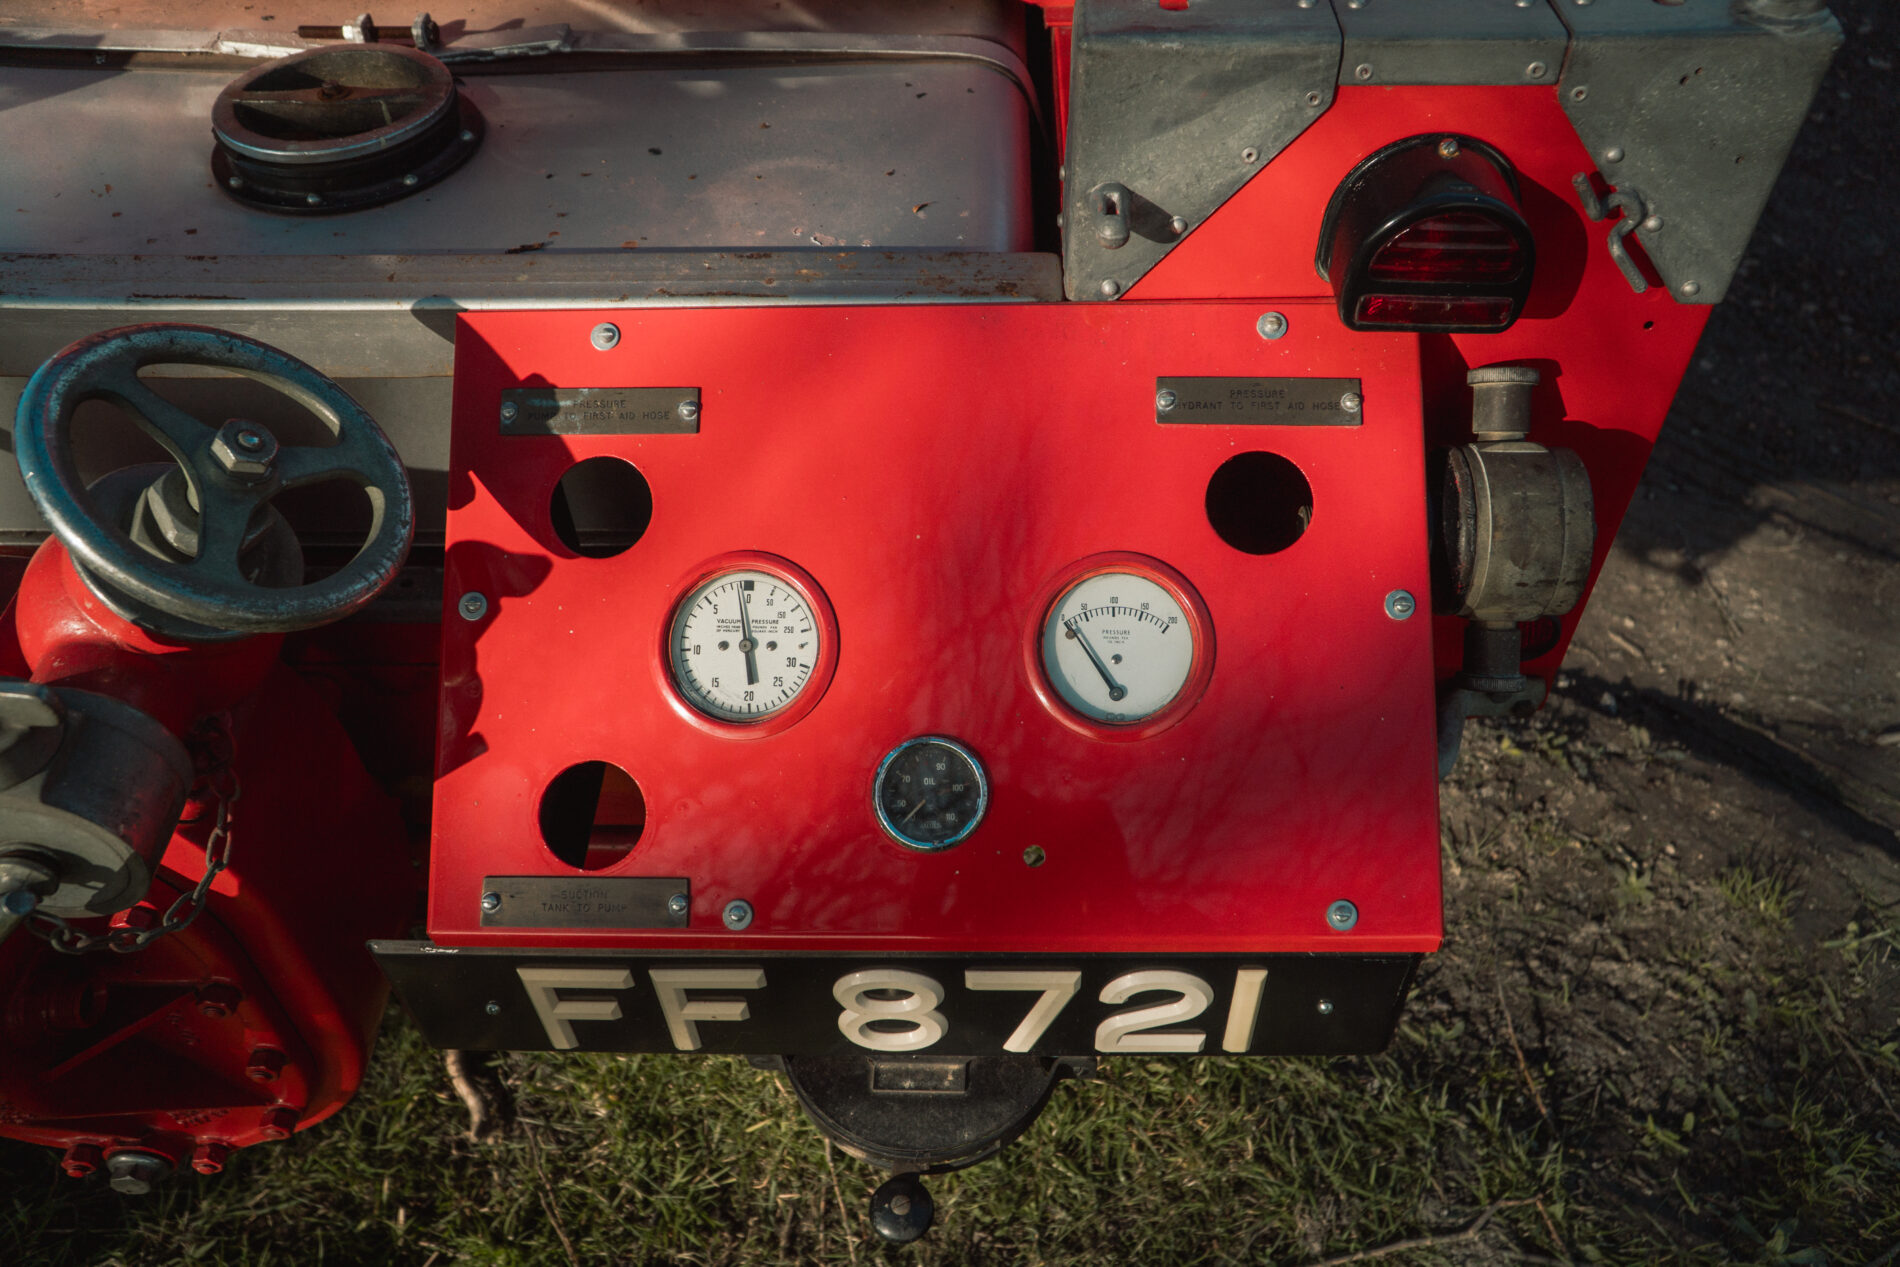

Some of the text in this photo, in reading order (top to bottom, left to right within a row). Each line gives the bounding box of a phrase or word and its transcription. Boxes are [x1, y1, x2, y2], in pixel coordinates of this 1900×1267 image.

[1230, 389, 1286, 399] PRESSURE
[572, 399, 627, 409] PRESSURE
[1174, 402, 1341, 411] HYDRANT TO FIRST AID HOSE
[527, 411, 671, 421] PUMP TO FIRST AID HOSE
[766, 598, 774, 607] 50
[1109, 596, 1119, 604] 100
[713, 604, 719, 615] 5
[1080, 603, 1088, 611] 50
[1140, 602, 1150, 611] 150
[777, 611, 787, 619] 150
[1167, 616, 1178, 624] 200
[783, 626, 795, 634] 250
[693, 644, 701, 655] 10
[786, 656, 797, 668] 30
[711, 677, 720, 688] 15
[773, 676, 784, 687] 25
[743, 690, 754, 702] 20
[923, 777, 936, 785] OIL
[952, 784, 964, 792] 100
[945, 812, 956, 821] 110
[560, 889, 608, 899] SUCTION
[541, 903, 628, 913] TANK TO PUMP
[516, 968, 1269, 1053] FF 8721
